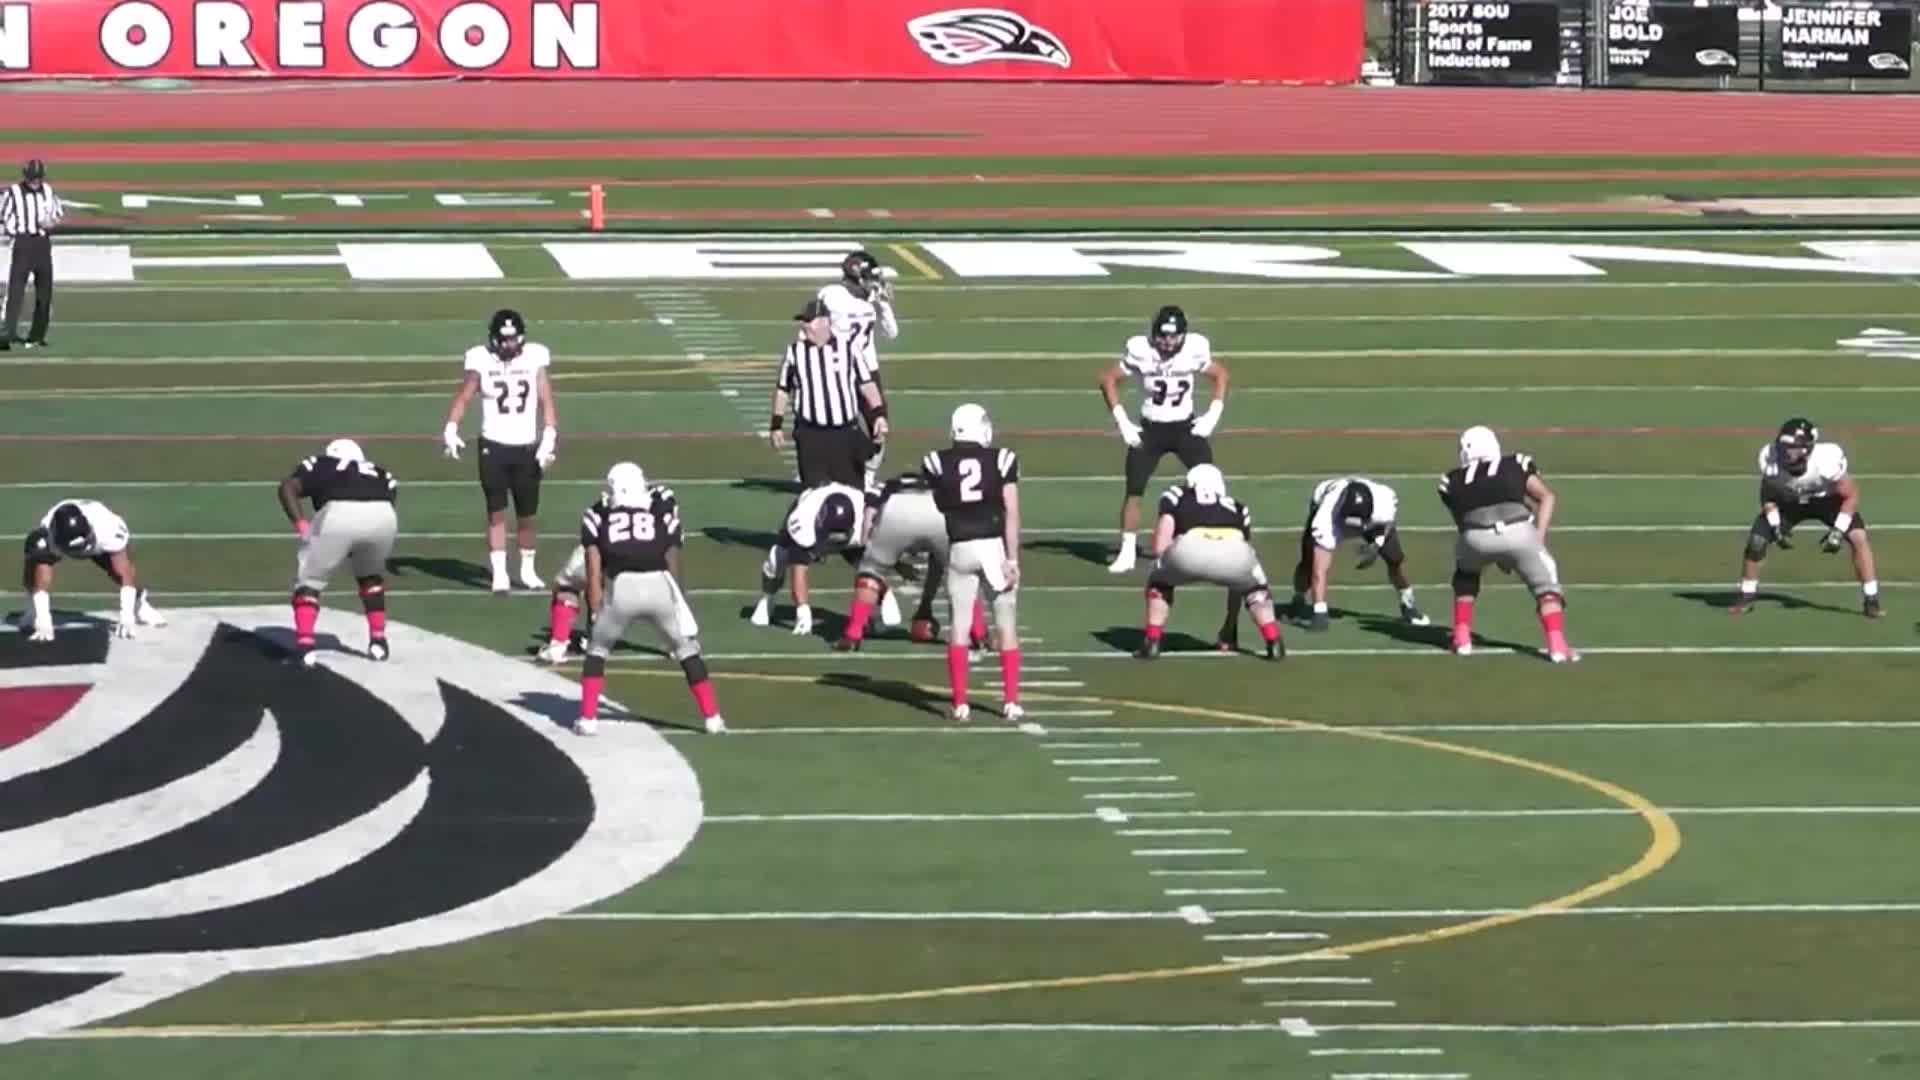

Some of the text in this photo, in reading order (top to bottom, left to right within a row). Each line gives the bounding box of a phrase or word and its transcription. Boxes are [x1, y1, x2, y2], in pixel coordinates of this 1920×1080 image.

[1428, 4, 1510, 18] 2017 SOU
[1609, 6, 1649, 22] JOE
[1783, 8, 1881, 27] JENNIFER
[98, 0, 600, 69] OREGON
[1428, 20, 1483, 36] Sports
[1609, 24, 1663, 41] BOLD
[1783, 27, 1869, 45] HARMAN
[1428, 36, 1532, 51] Hall of Fame
[1428, 53, 1511, 68] Inductees
[493, 379, 530, 415] 23
[958, 459, 984, 501] 2
[608, 511, 656, 544] 28
